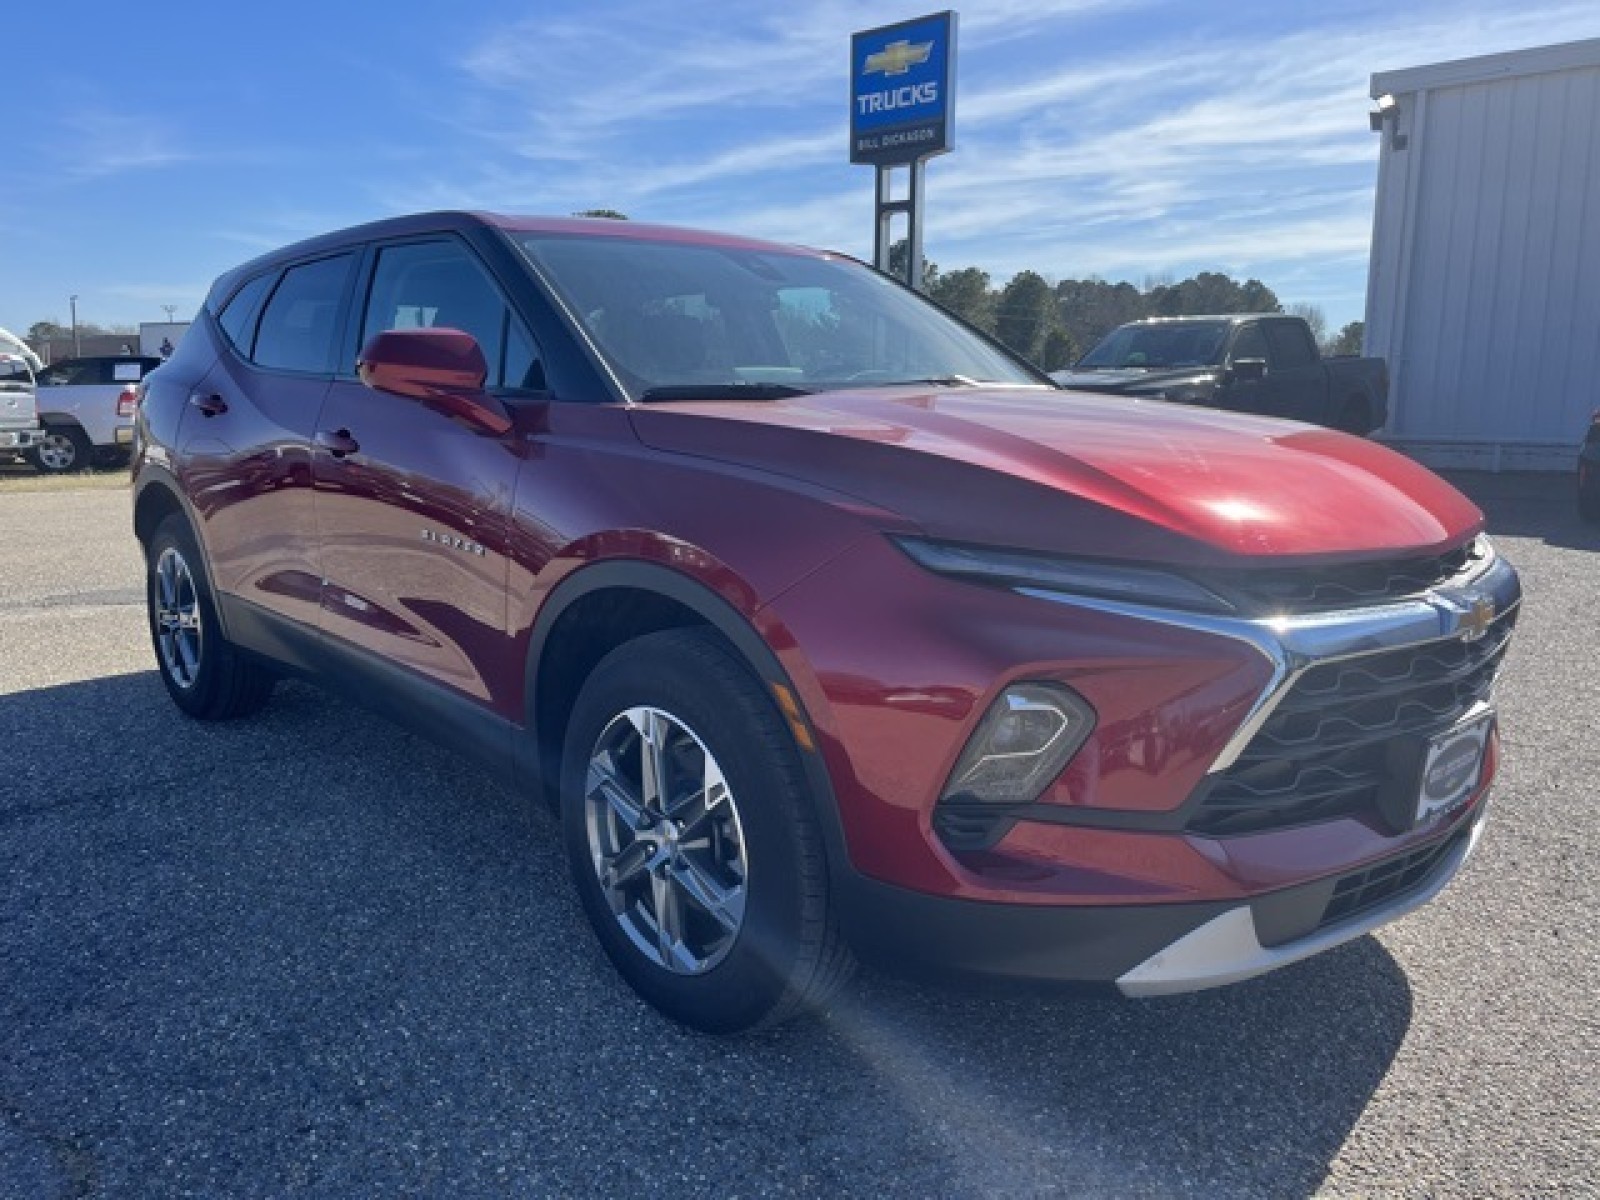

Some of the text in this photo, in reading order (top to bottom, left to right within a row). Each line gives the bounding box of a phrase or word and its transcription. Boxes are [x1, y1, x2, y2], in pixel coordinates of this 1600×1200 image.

[857, 81, 938, 115] TRUCKS
[857, 138, 879, 151] BILL
[421, 528, 486, 556] BLAZER
